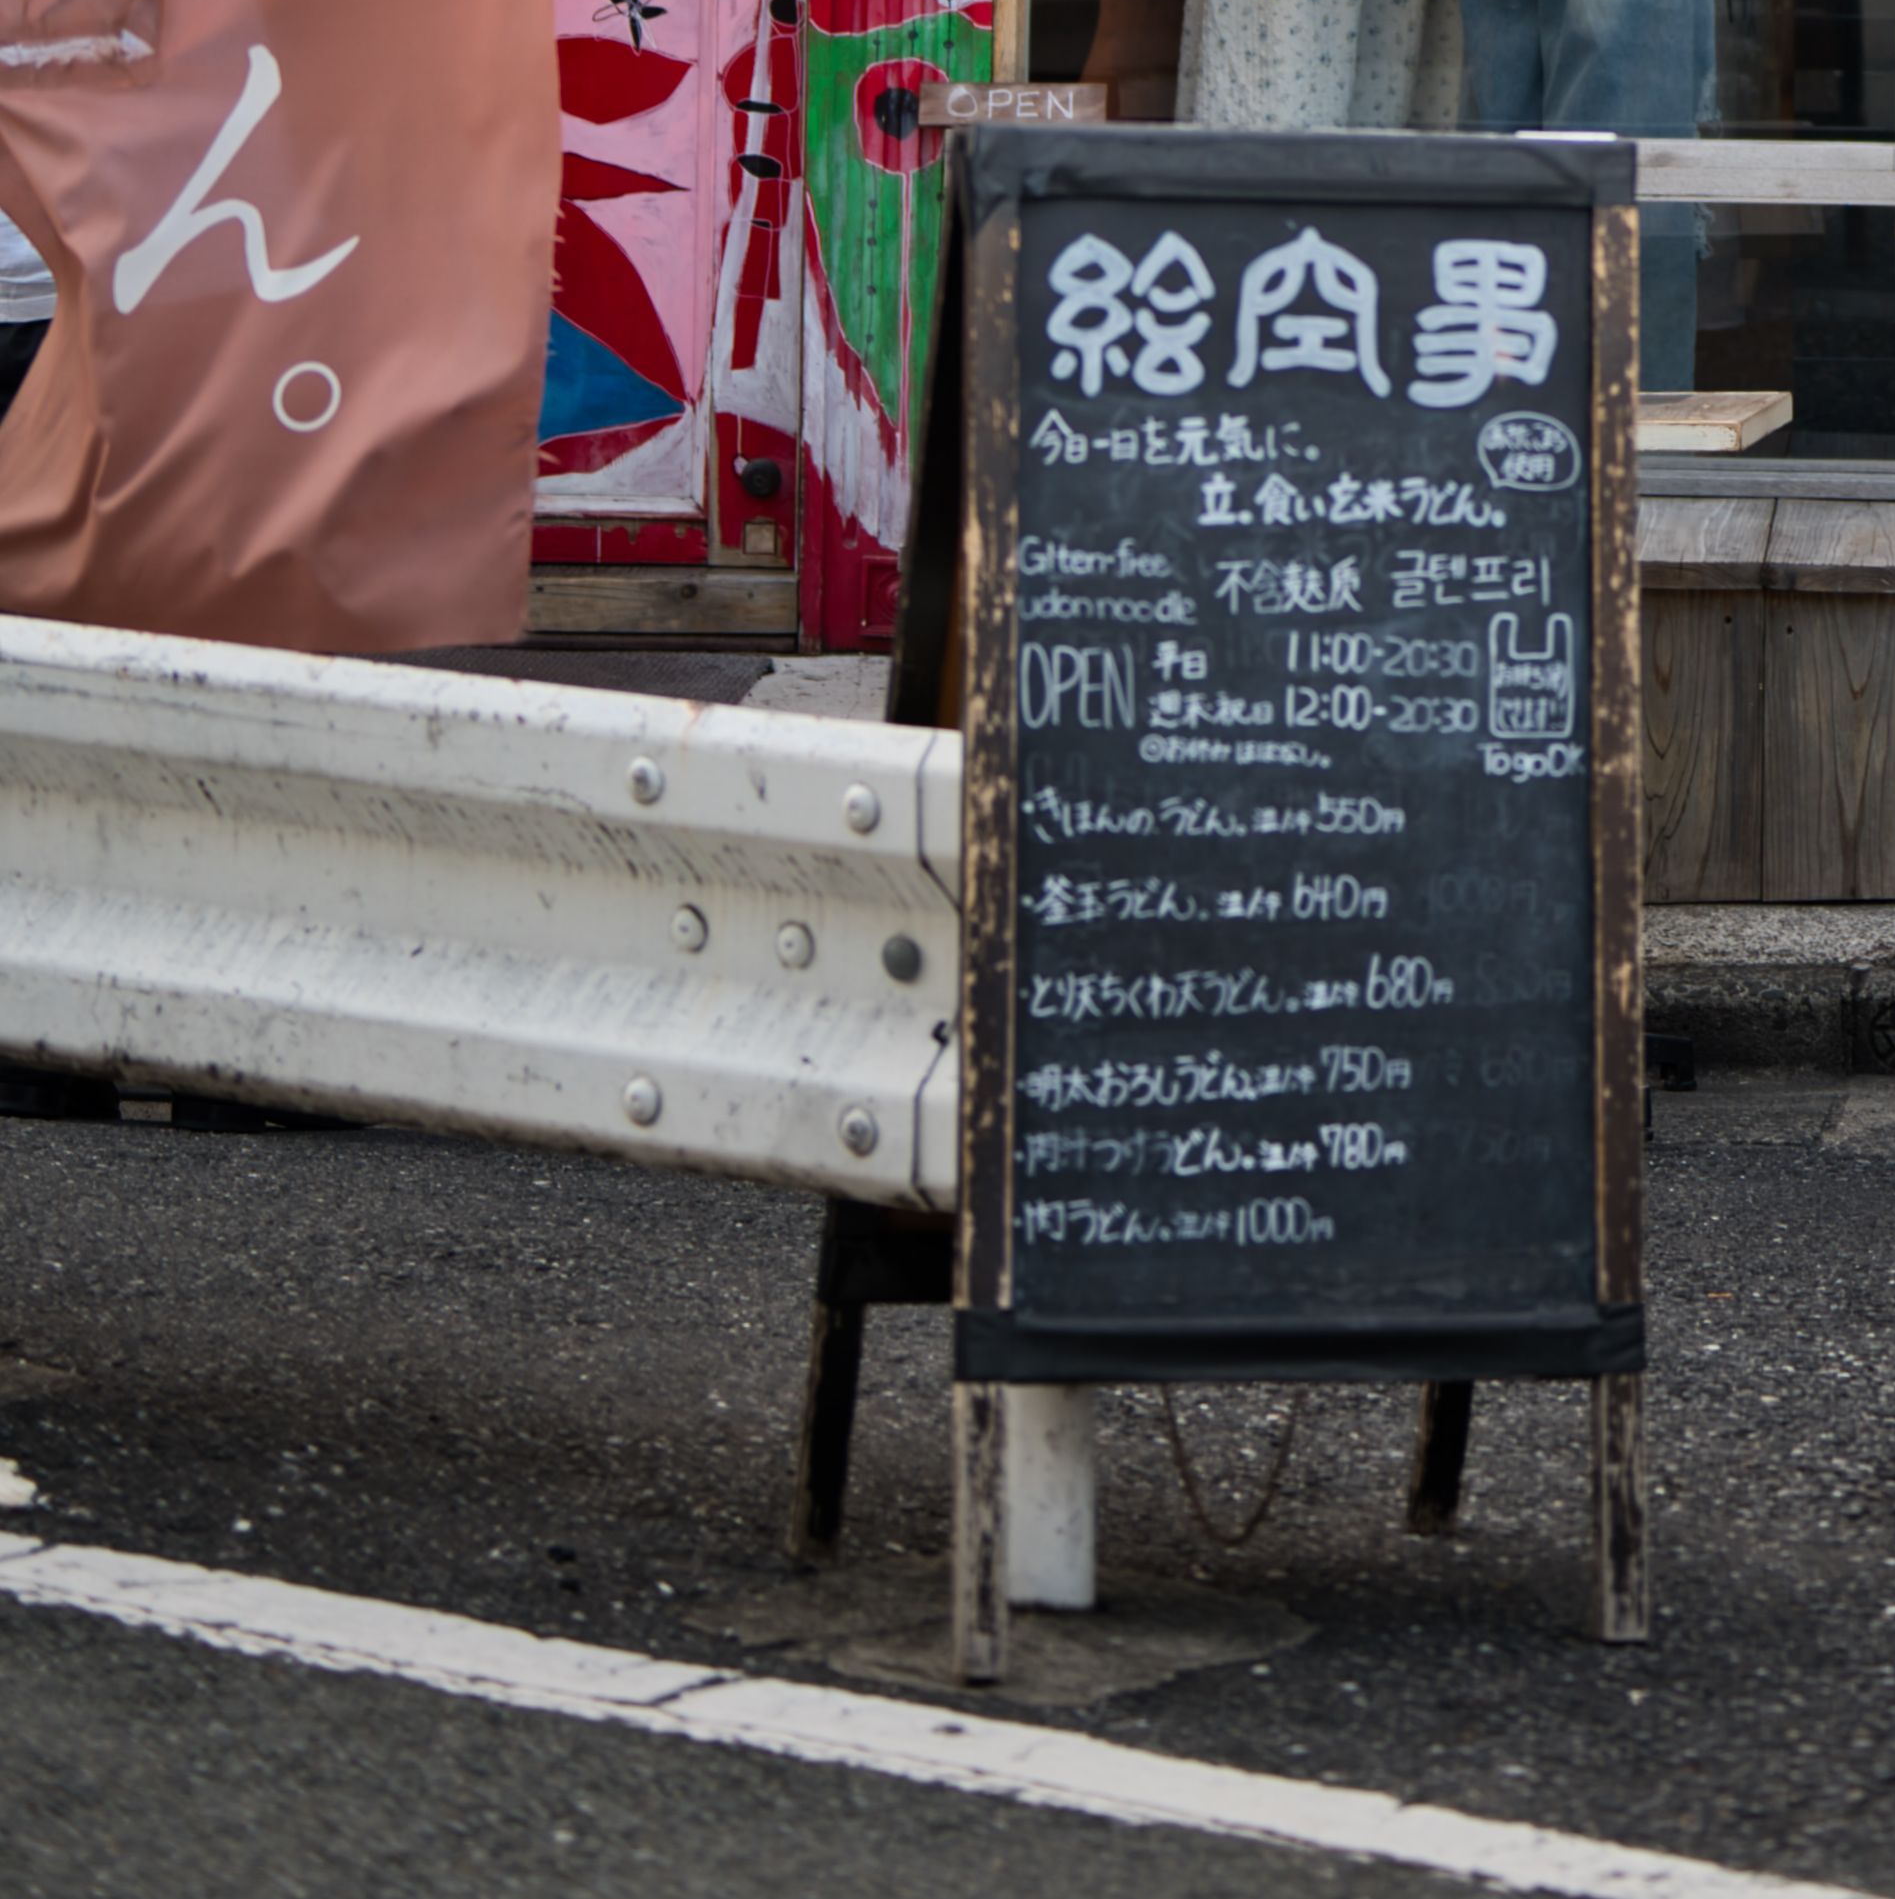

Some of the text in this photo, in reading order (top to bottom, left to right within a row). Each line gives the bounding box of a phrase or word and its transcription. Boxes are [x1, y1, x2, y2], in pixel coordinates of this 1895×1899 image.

[946, 85, 1075, 120] OPEN
[1046, 226, 1559, 408] 絵空事
[1018, 586, 1094, 621] udon
[1151, 639, 1208, 682] 平日
[1020, 641, 1136, 731] OPEN
